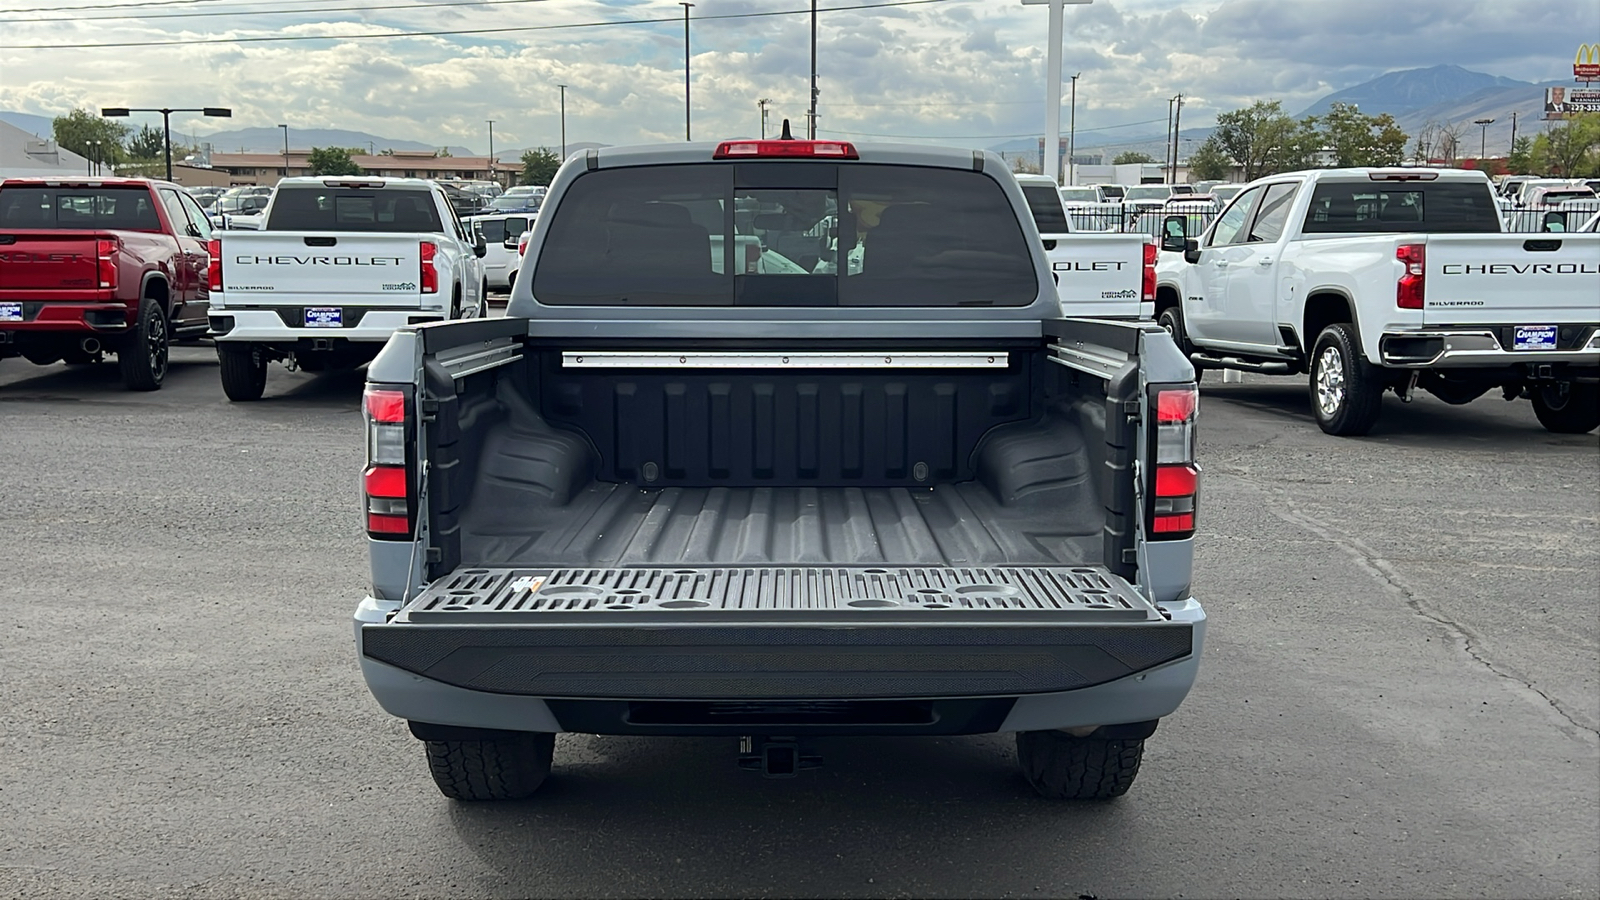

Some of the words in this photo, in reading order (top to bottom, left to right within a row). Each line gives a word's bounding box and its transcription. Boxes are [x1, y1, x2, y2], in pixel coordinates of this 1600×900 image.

[236, 256, 405, 265] CHEVROLET
[1443, 264, 1600, 274] CHEVROL
[307, 310, 340, 318] CHAMPION
[1516, 330, 1554, 338] CHAMPION
